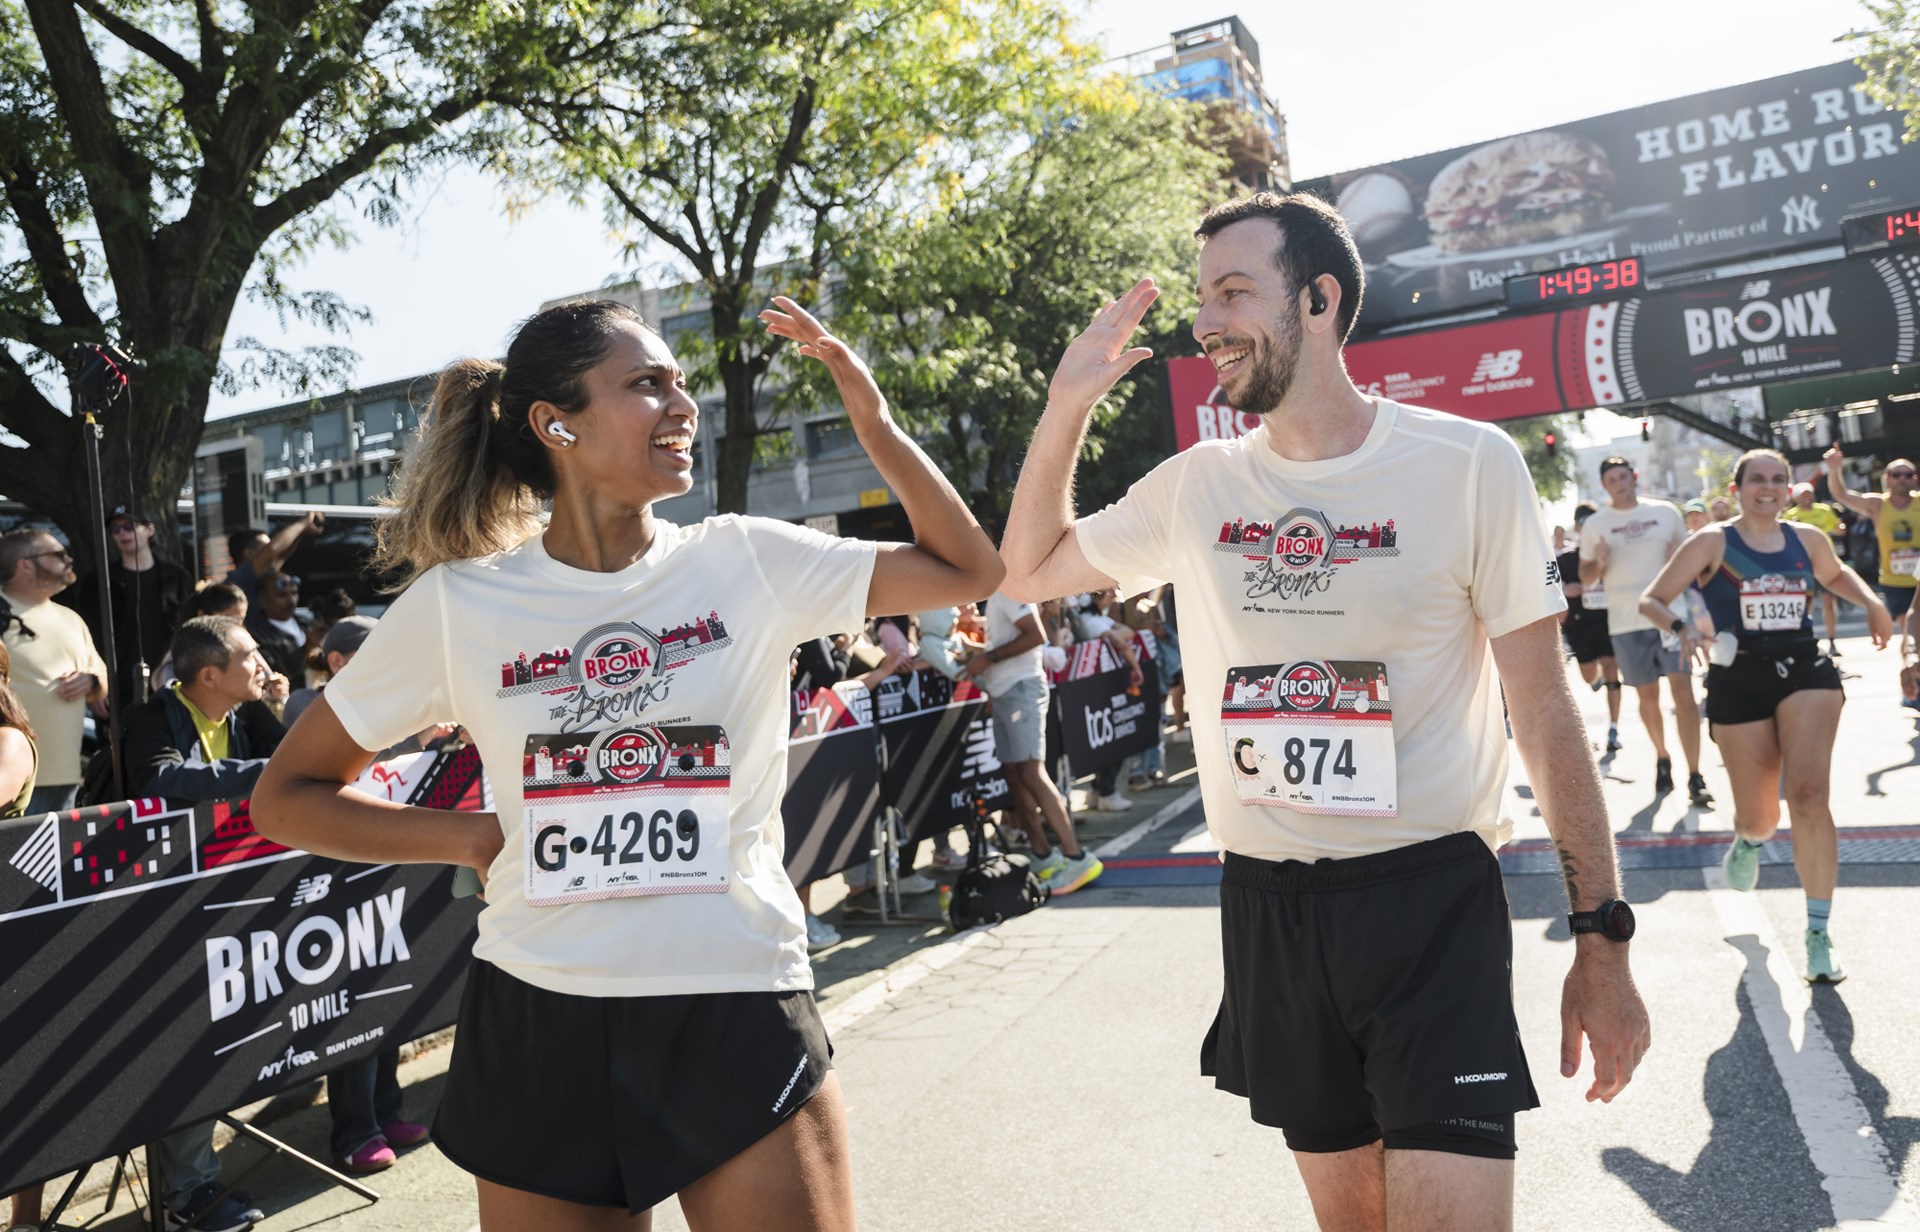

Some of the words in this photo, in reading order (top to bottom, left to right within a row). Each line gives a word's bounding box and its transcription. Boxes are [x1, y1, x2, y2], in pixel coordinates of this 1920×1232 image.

[1635, 99, 1791, 163] HOME
[1680, 122, 1898, 196] FLAVOR
[1630, 232, 1680, 255] Proud
[1684, 220, 1745, 245] Partner
[1749, 215, 1769, 235] of
[1684, 287, 1837, 356] BRONX
[1757, 343, 1787, 364] MILE
[1486, 377, 1534, 393] balance
[1276, 536, 1324, 556] BRONX
[1746, 604, 1755, 619] E
[585, 646, 651, 680] BRONX
[617, 672, 633, 683] MILE
[1280, 679, 1330, 697] BRONX
[658, 716, 691, 727] RUNNERS
[1084, 705, 1114, 749] tcs
[600, 745, 658, 768] BRONX
[1234, 737, 1260, 775] C
[1283, 737, 1357, 785] 874
[534, 825, 567, 871] G
[590, 809, 701, 866] 4269
[205, 886, 411, 1022] BRONX
[289, 1002, 309, 1032] 10
[311, 989, 350, 1025] MILE
[326, 1040, 346, 1056] RUN
[346, 1034, 365, 1050] FOR
[365, 1026, 384, 1042] LIFE
[1459, 1118, 1477, 1128] THE
